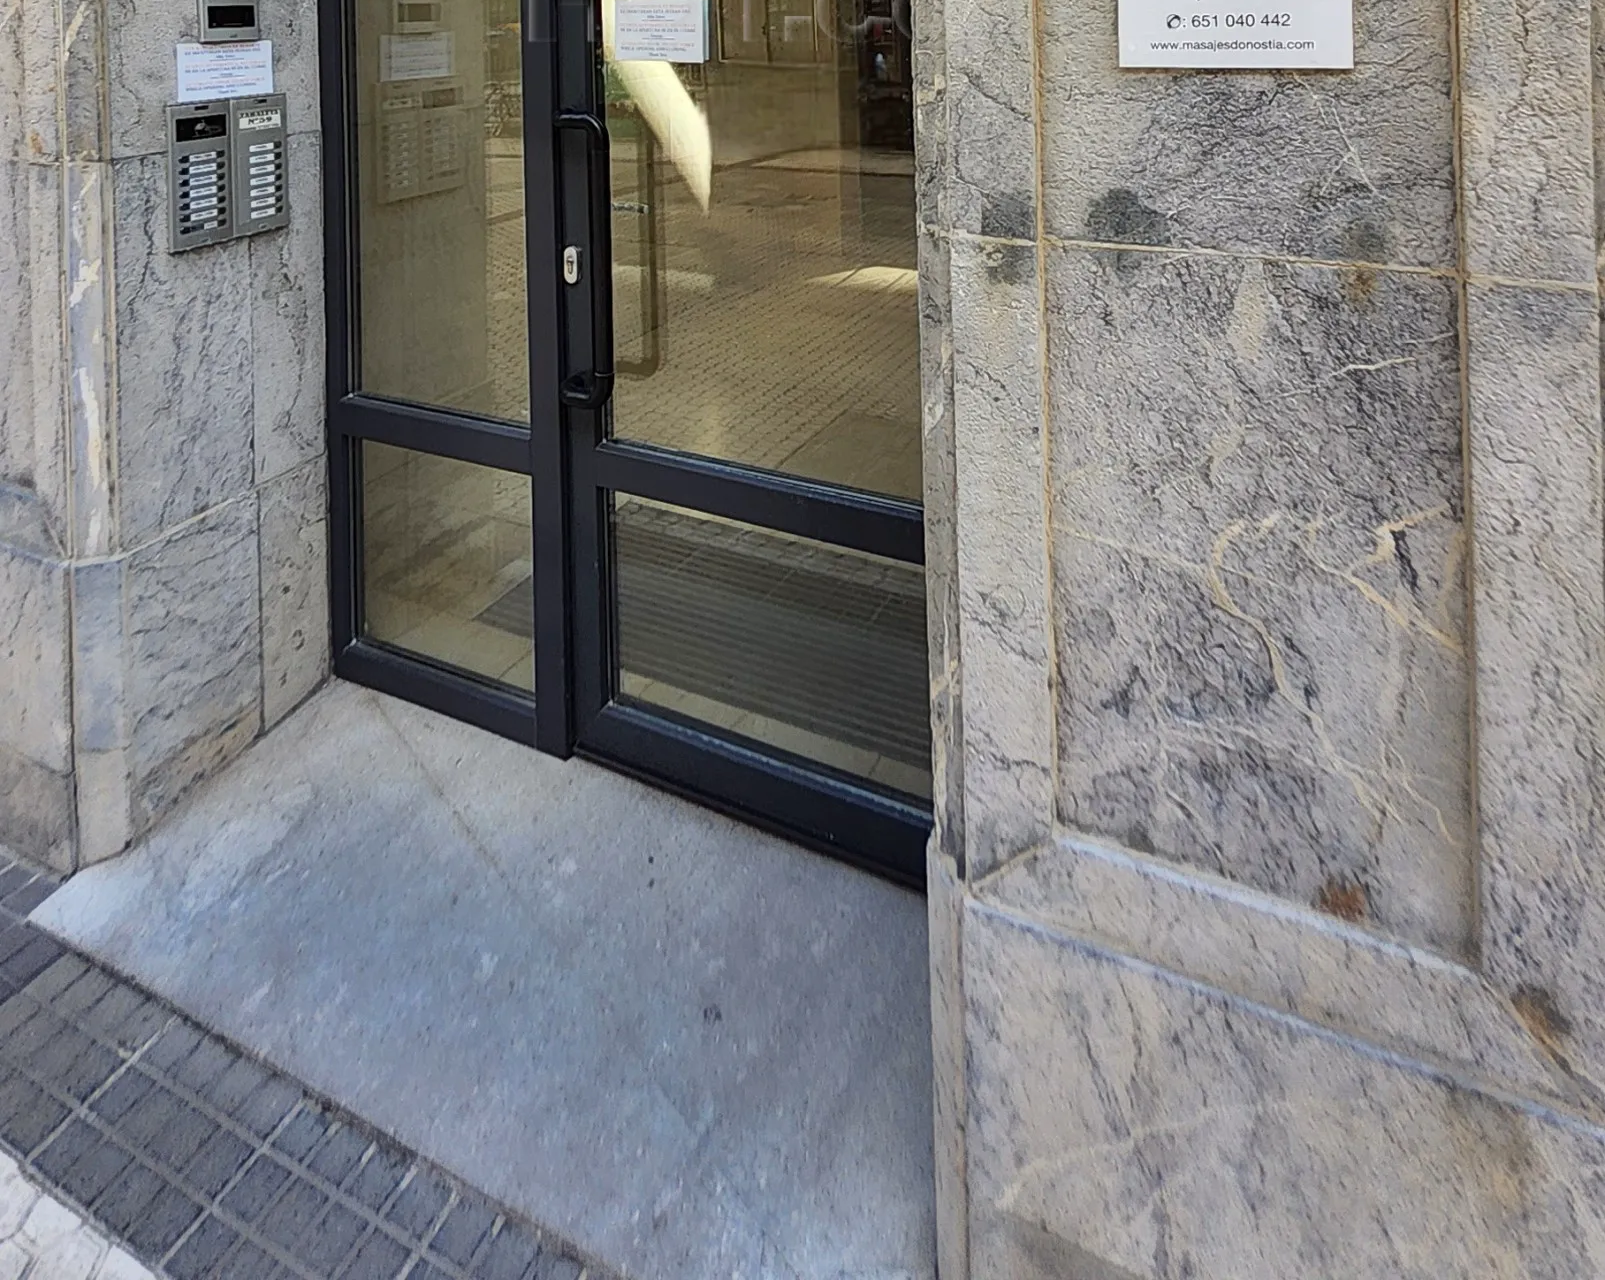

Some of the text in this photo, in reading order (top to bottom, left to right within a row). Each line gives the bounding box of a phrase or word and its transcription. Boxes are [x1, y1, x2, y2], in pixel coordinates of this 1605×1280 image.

[1191, 13, 1291, 28] 651 040 442
[1150, 39, 1315, 52] www.masajesdonostia.com
